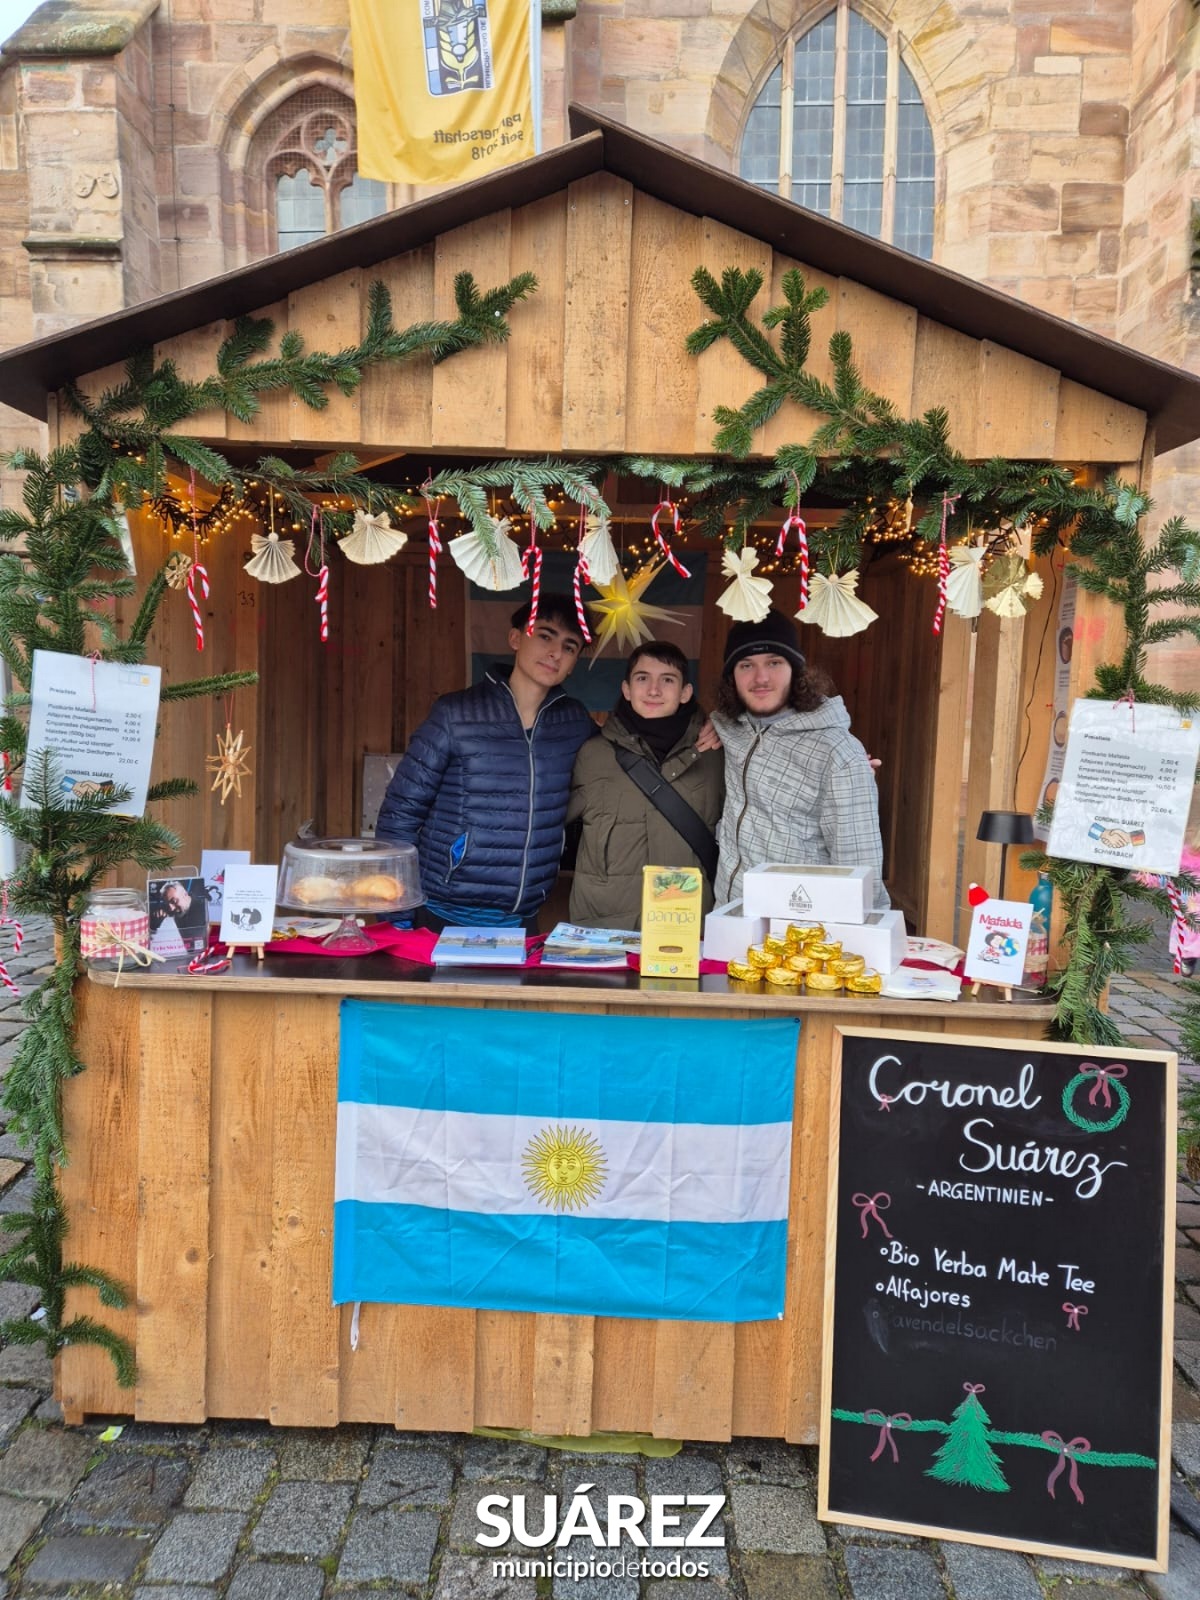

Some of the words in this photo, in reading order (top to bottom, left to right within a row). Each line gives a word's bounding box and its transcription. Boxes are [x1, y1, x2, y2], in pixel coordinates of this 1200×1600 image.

[978, 914, 1023, 930] Mafalda
[869, 1055, 1042, 1110] Coronel
[959, 1118, 1128, 1199] Suárez
[886, 1275, 971, 1308] Alfajores
[933, 1247, 987, 1278] Yerba
[998, 1257, 1050, 1287] Mate
[1058, 1264, 1096, 1294] Tee
